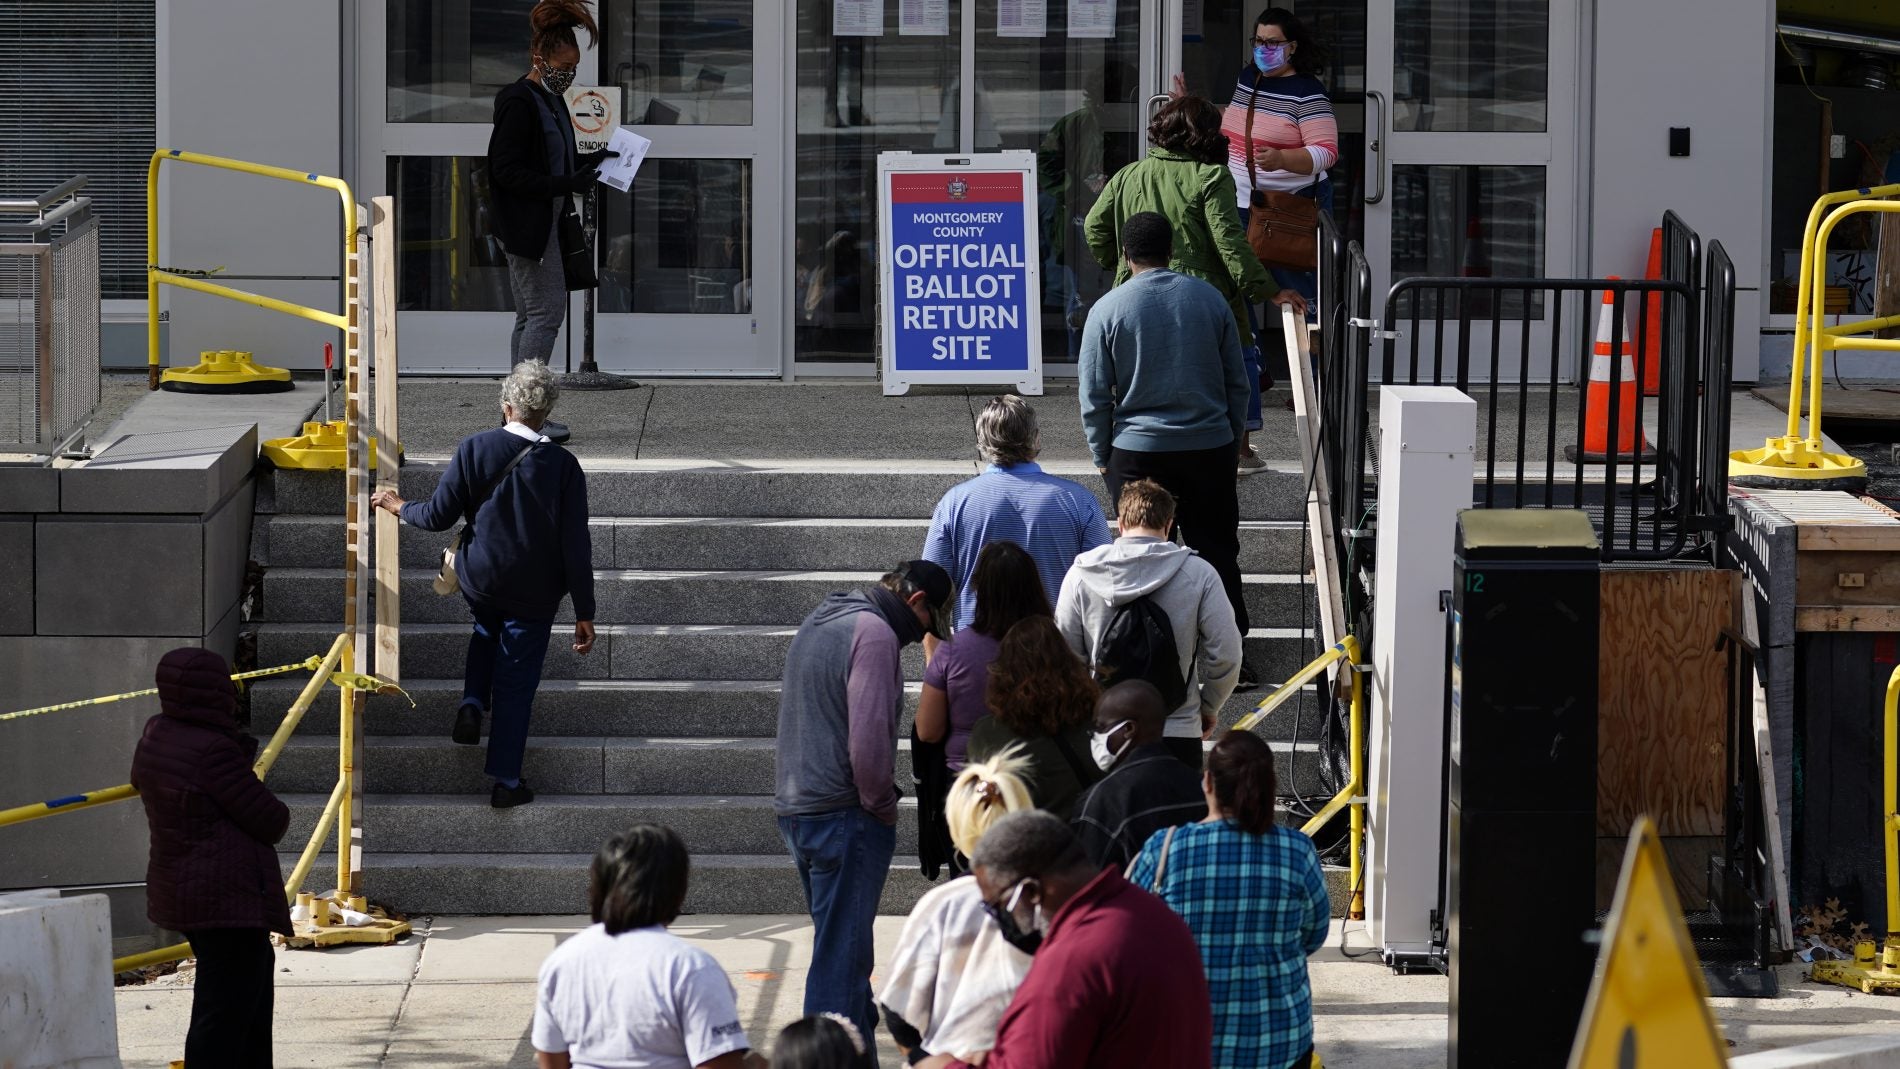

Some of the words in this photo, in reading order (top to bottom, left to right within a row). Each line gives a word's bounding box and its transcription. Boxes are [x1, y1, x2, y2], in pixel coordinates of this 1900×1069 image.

[913, 212, 1004, 224] MONTGOMERY
[932, 226, 985, 238] COUNTY
[894, 243, 1025, 268] OFFICIAL
[905, 274, 1016, 299] BALLOT
[903, 305, 1019, 329] RETURN
[931, 335, 992, 360] SITE
[1466, 573, 1485, 593] 12
